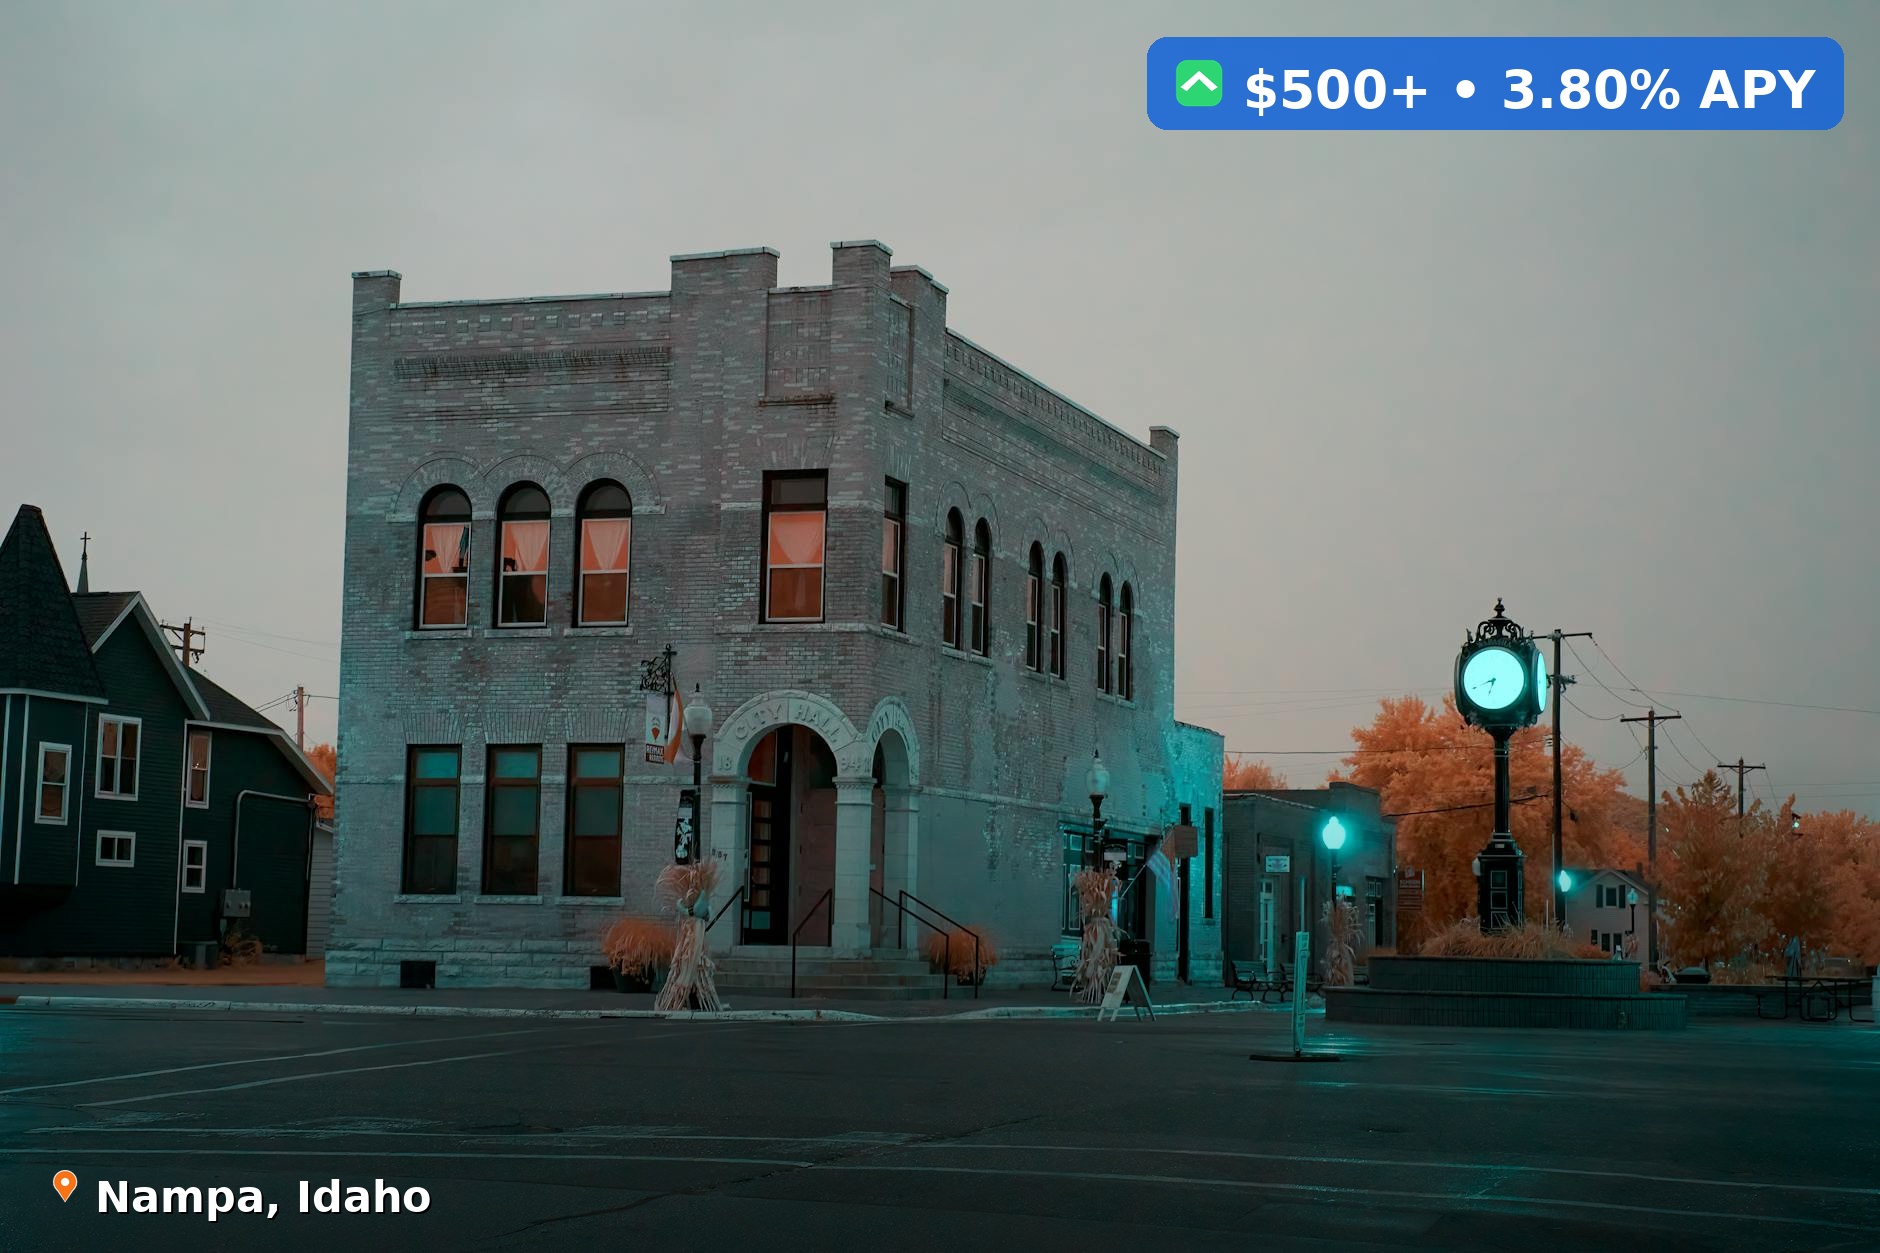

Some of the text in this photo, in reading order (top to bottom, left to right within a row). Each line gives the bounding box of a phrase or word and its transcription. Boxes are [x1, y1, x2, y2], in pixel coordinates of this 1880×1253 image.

[735, 703, 841, 743] CITY HALL
[720, 756, 732, 771] 18
